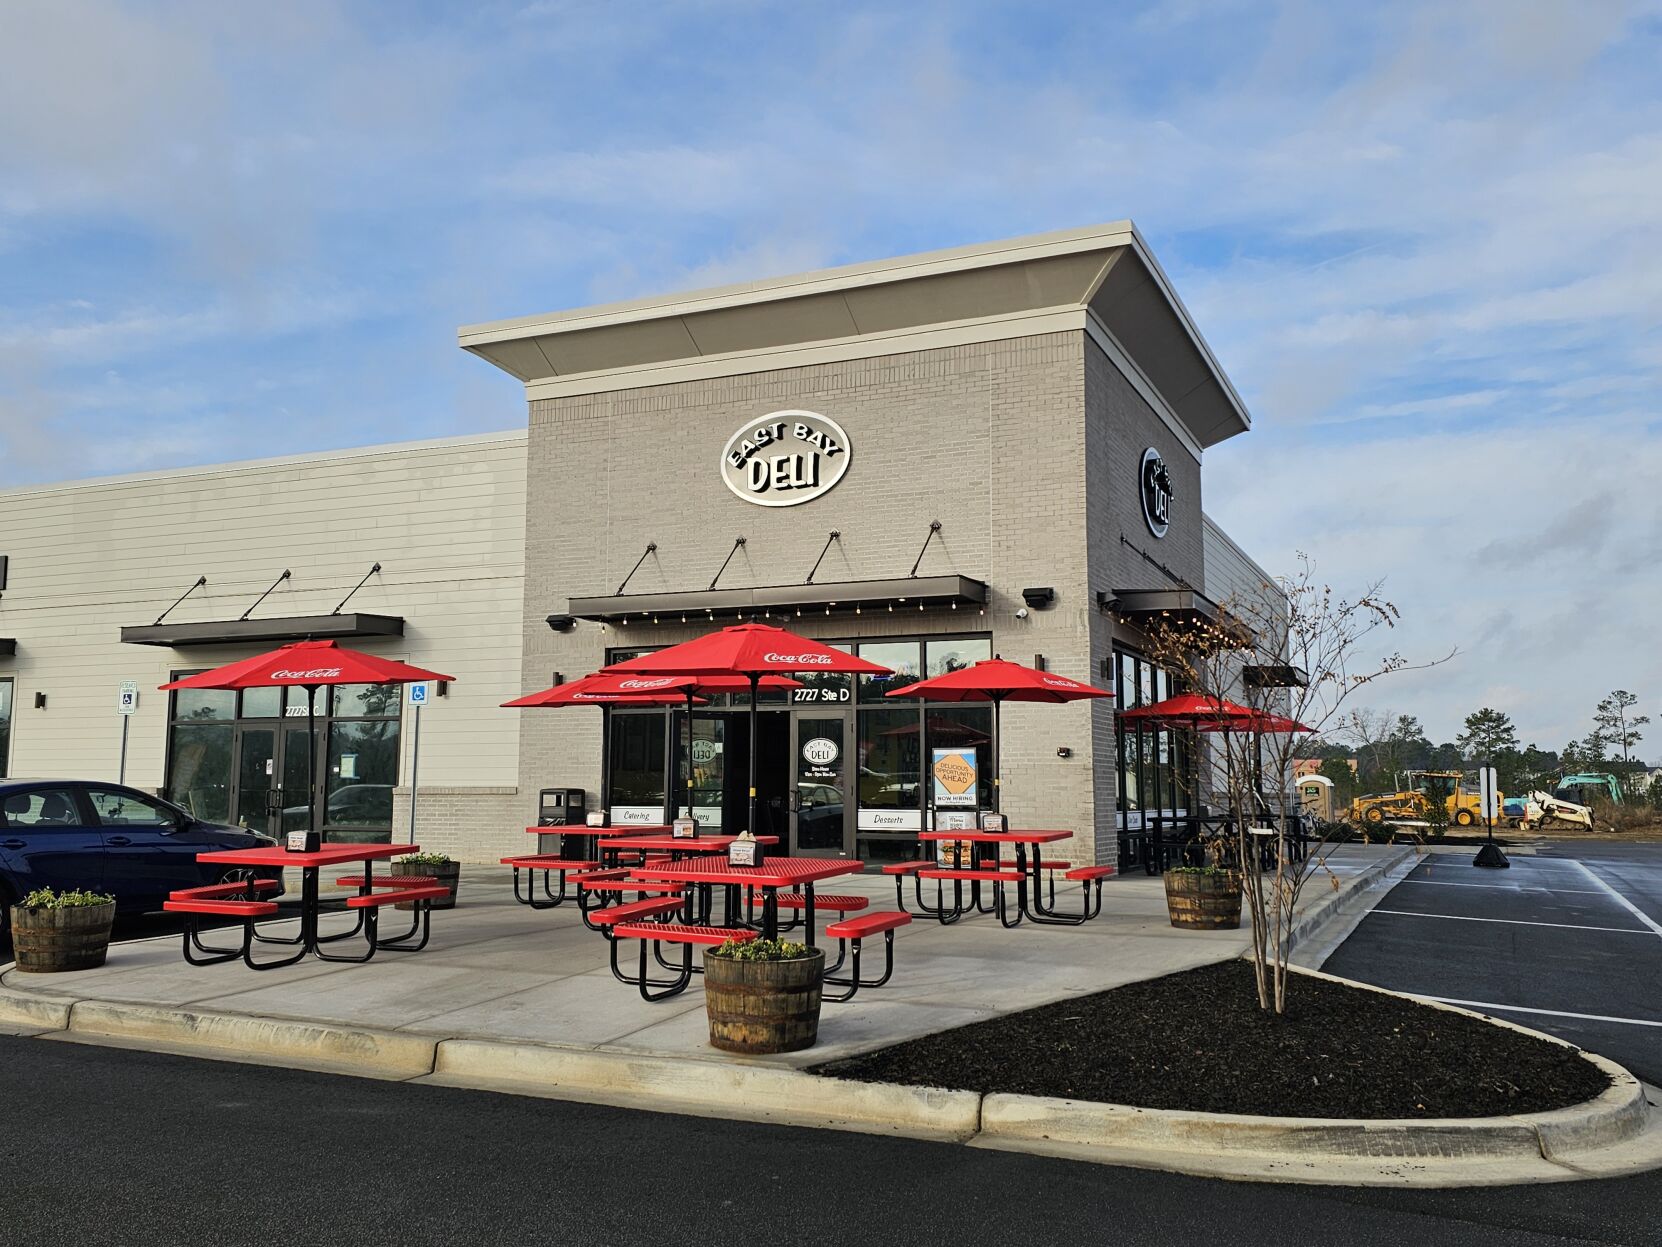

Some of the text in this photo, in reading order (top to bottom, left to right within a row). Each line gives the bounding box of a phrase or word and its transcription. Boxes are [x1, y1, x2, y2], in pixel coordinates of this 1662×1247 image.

[727, 422, 844, 470] EAST BAY
[747, 451, 820, 493] DELI
[763, 652, 833, 665] Coca-Cola
[794, 688, 850, 701] 2727 Ste D
[285, 705, 303, 717] 2727
[313, 705, 320, 716] C
[811, 750, 829, 760] DELI
[936, 767, 974, 778] OPPORTUNITY
[940, 762, 969, 772] DELICIOUS
[942, 774, 968, 784] AHEAD
[623, 810, 650, 822] Catering
[873, 814, 904, 824] Desserts
